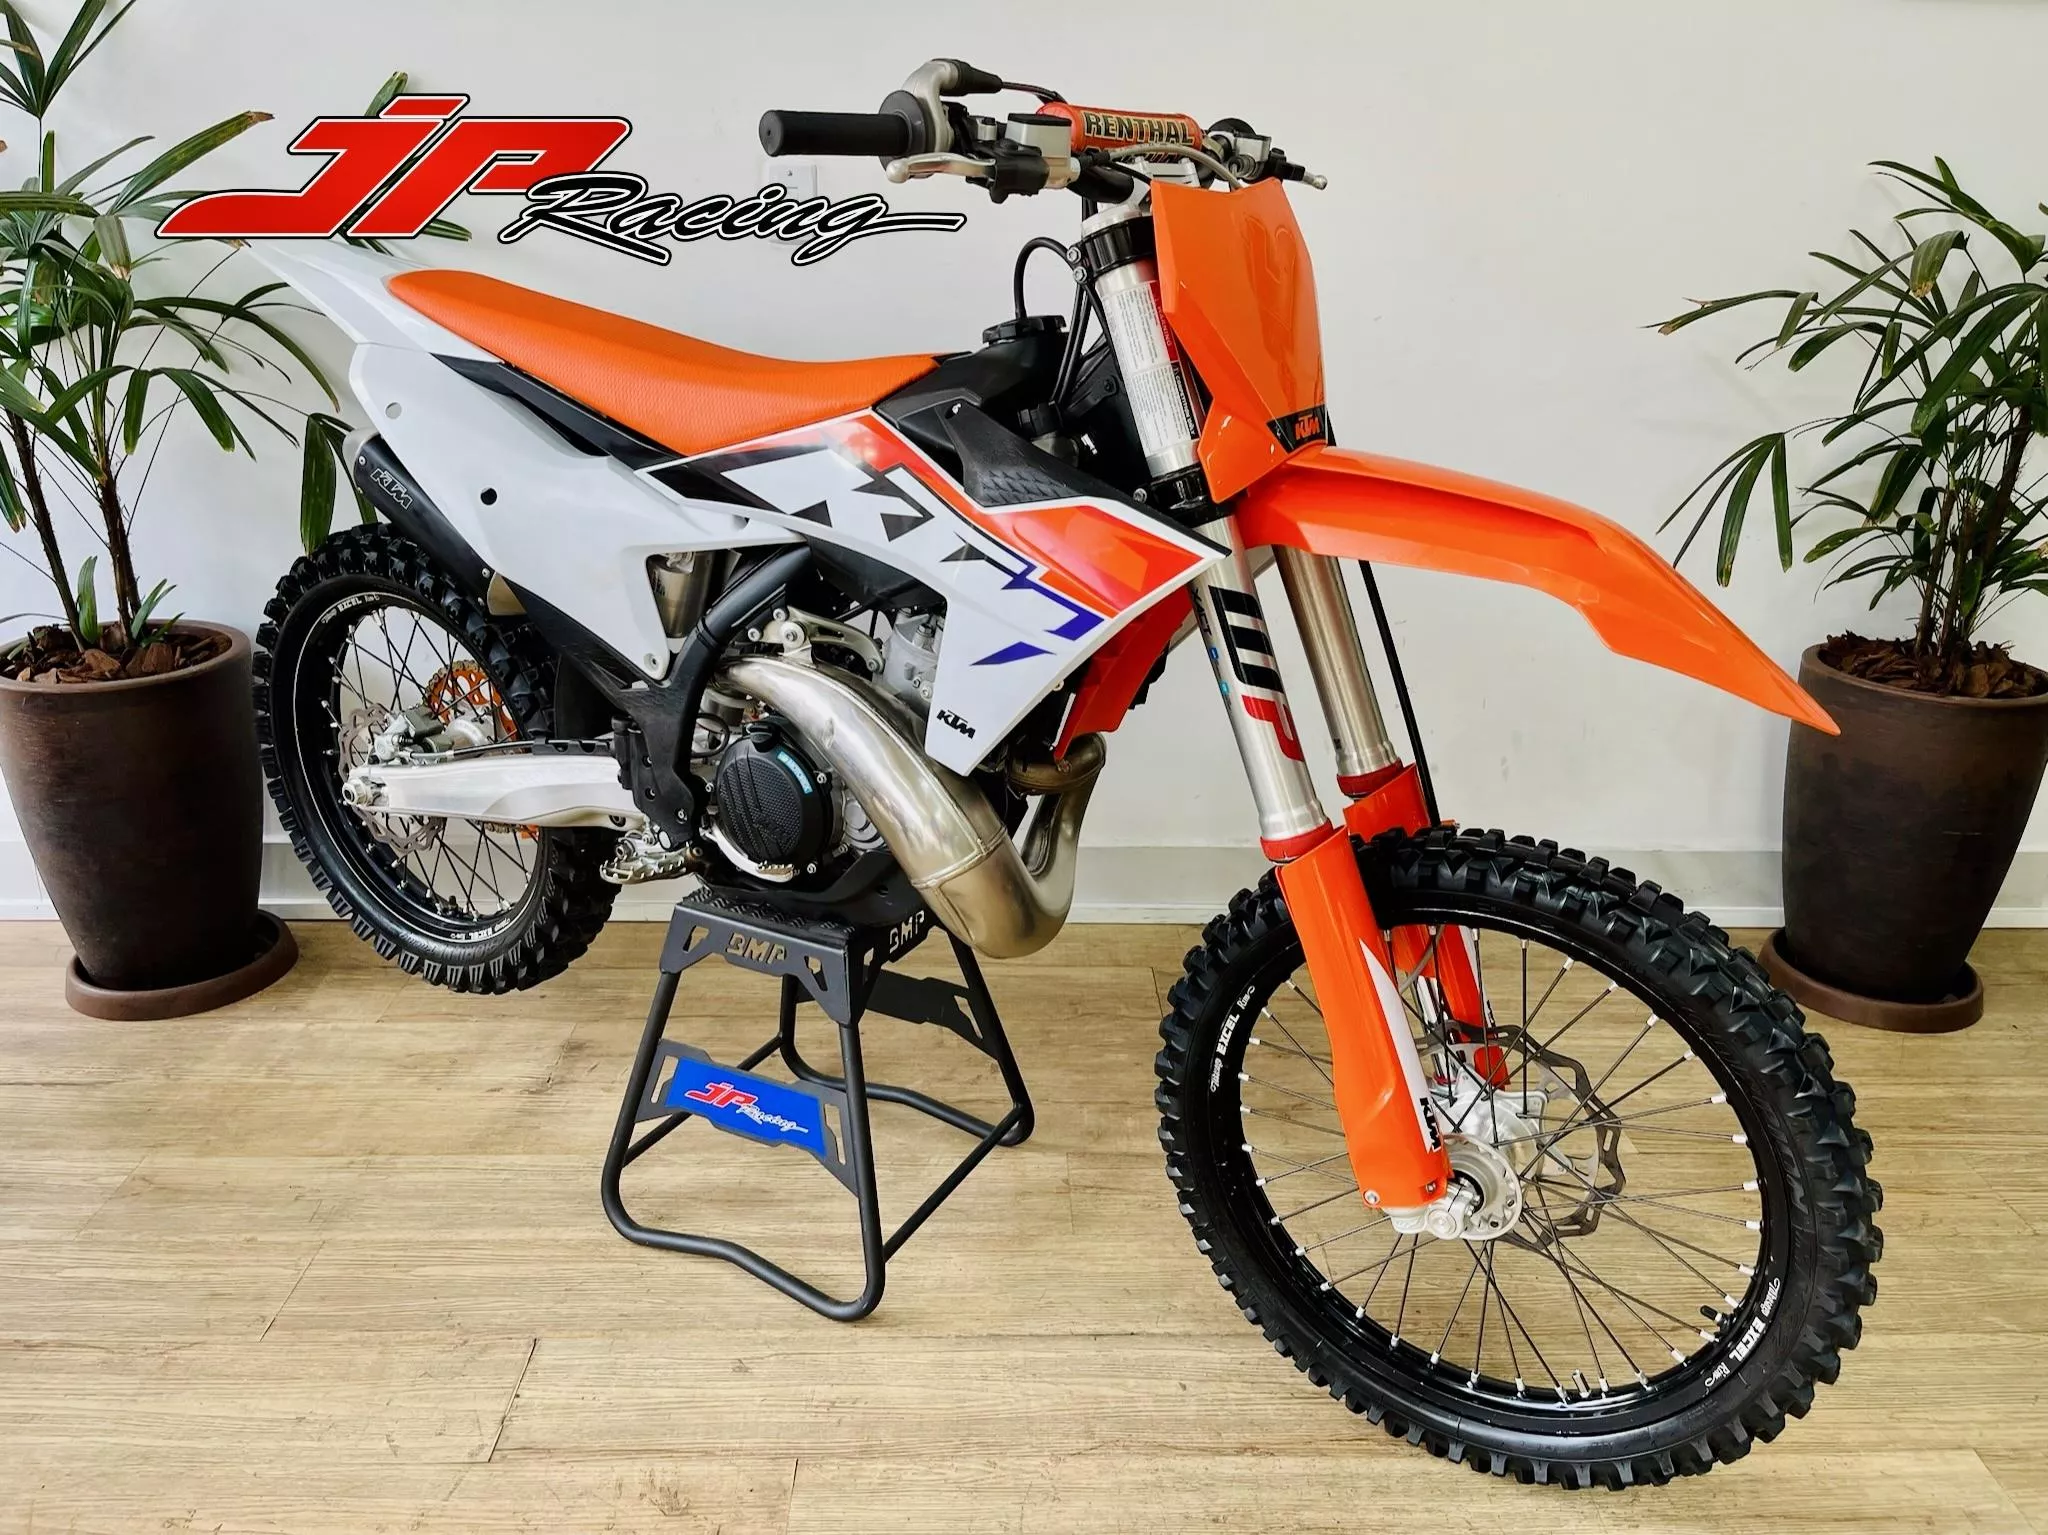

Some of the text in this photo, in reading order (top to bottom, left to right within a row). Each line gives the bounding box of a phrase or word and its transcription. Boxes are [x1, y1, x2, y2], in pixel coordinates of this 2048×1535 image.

[1081, 110, 1195, 145] RENTHAL
[1295, 414, 1320, 440] KTM
[370, 468, 413, 510] KTM
[937, 709, 976, 740] KTM
[726, 932, 787, 965] BMP
[890, 910, 925, 953] BMP
[1216, 1013, 1240, 1056] EXCEL
[684, 1082, 759, 1109] JP
[1420, 1097, 1441, 1150] KTM
[1728, 1316, 1766, 1362] EXCEL
